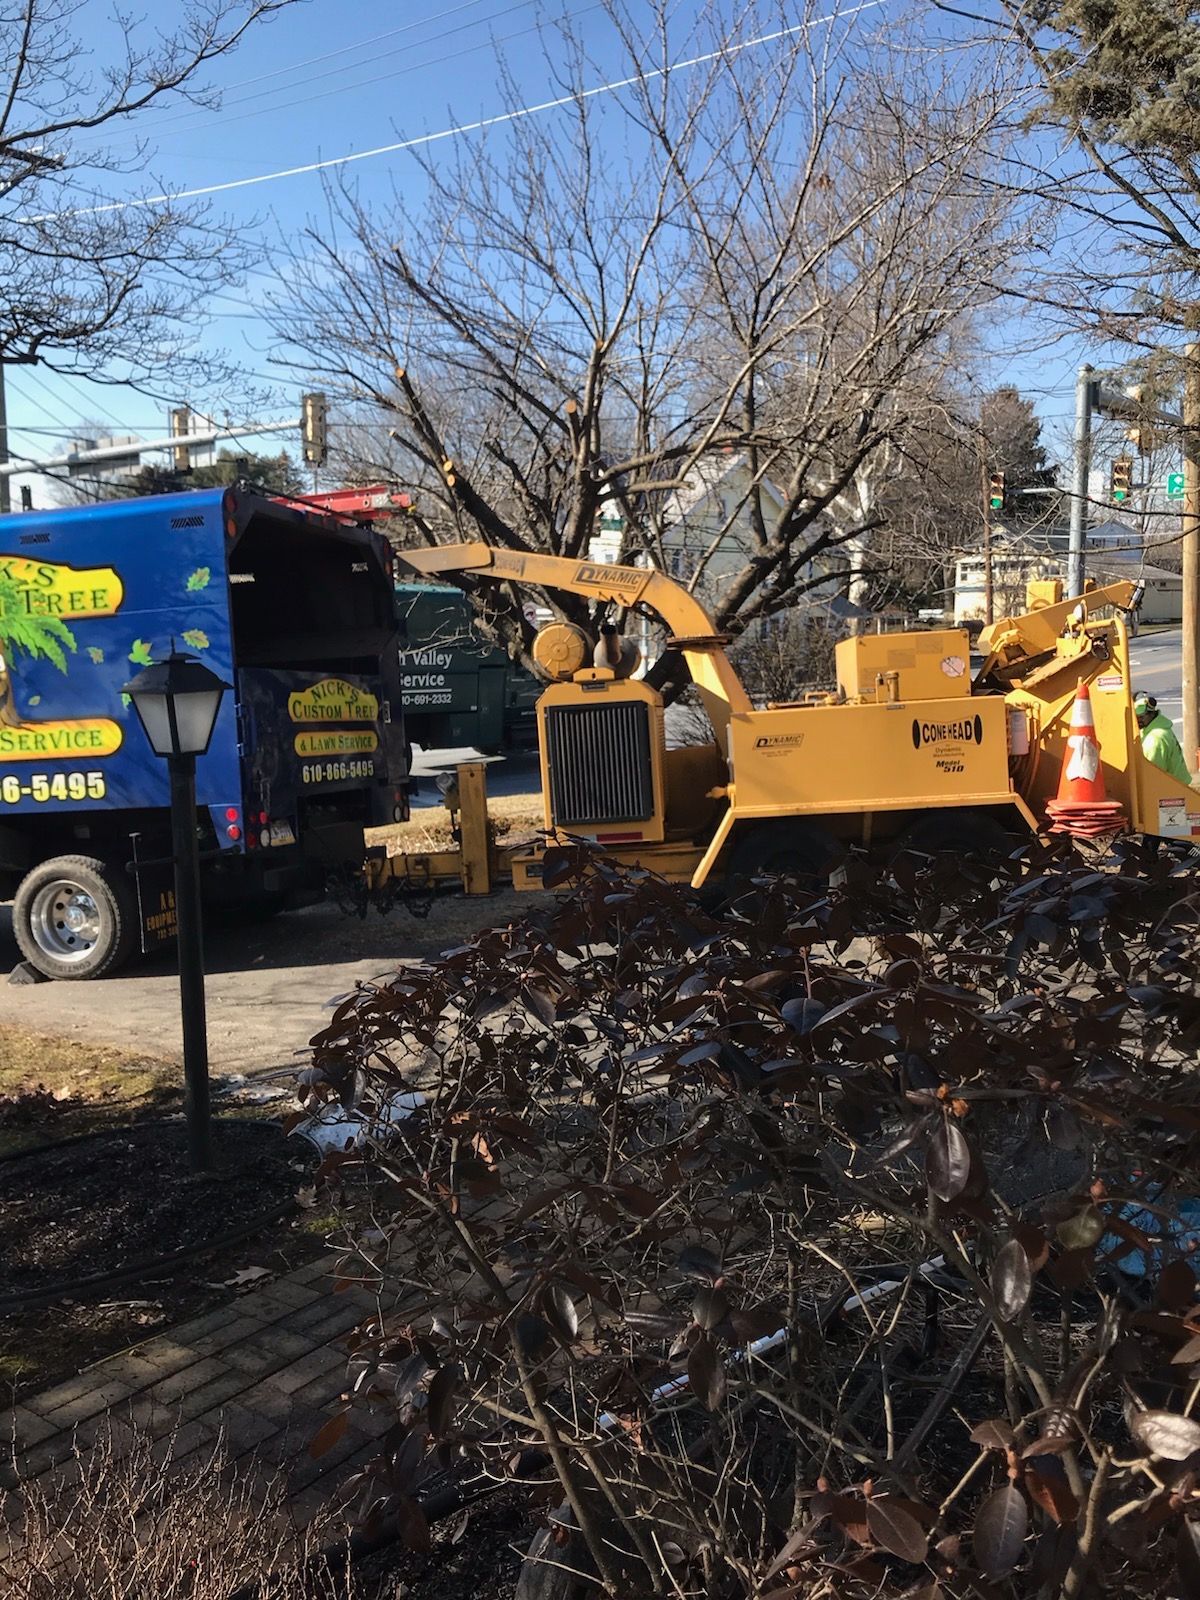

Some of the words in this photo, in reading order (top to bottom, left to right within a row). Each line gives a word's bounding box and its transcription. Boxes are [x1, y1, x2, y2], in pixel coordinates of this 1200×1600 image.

[575, 566, 643, 587] DYNAMIC
[16, 588, 109, 614] TREE
[412, 650, 453, 669] Valley
[311, 681, 360, 703] NICK'S
[292, 700, 343, 720] CUSTOM
[345, 701, 375, 719] TREE
[0, 729, 102, 751] SERVICE
[300, 739, 307, 752] &
[310, 736, 336, 751] LAWN
[338, 734, 372, 750] SERVICE
[756, 735, 801, 748] DYNAMIC
[302, 761, 374, 784] 610-866-5495
[936, 760, 961, 768] Model
[943, 765, 964, 773] 510
[0, 771, 106, 804] 6-5495
